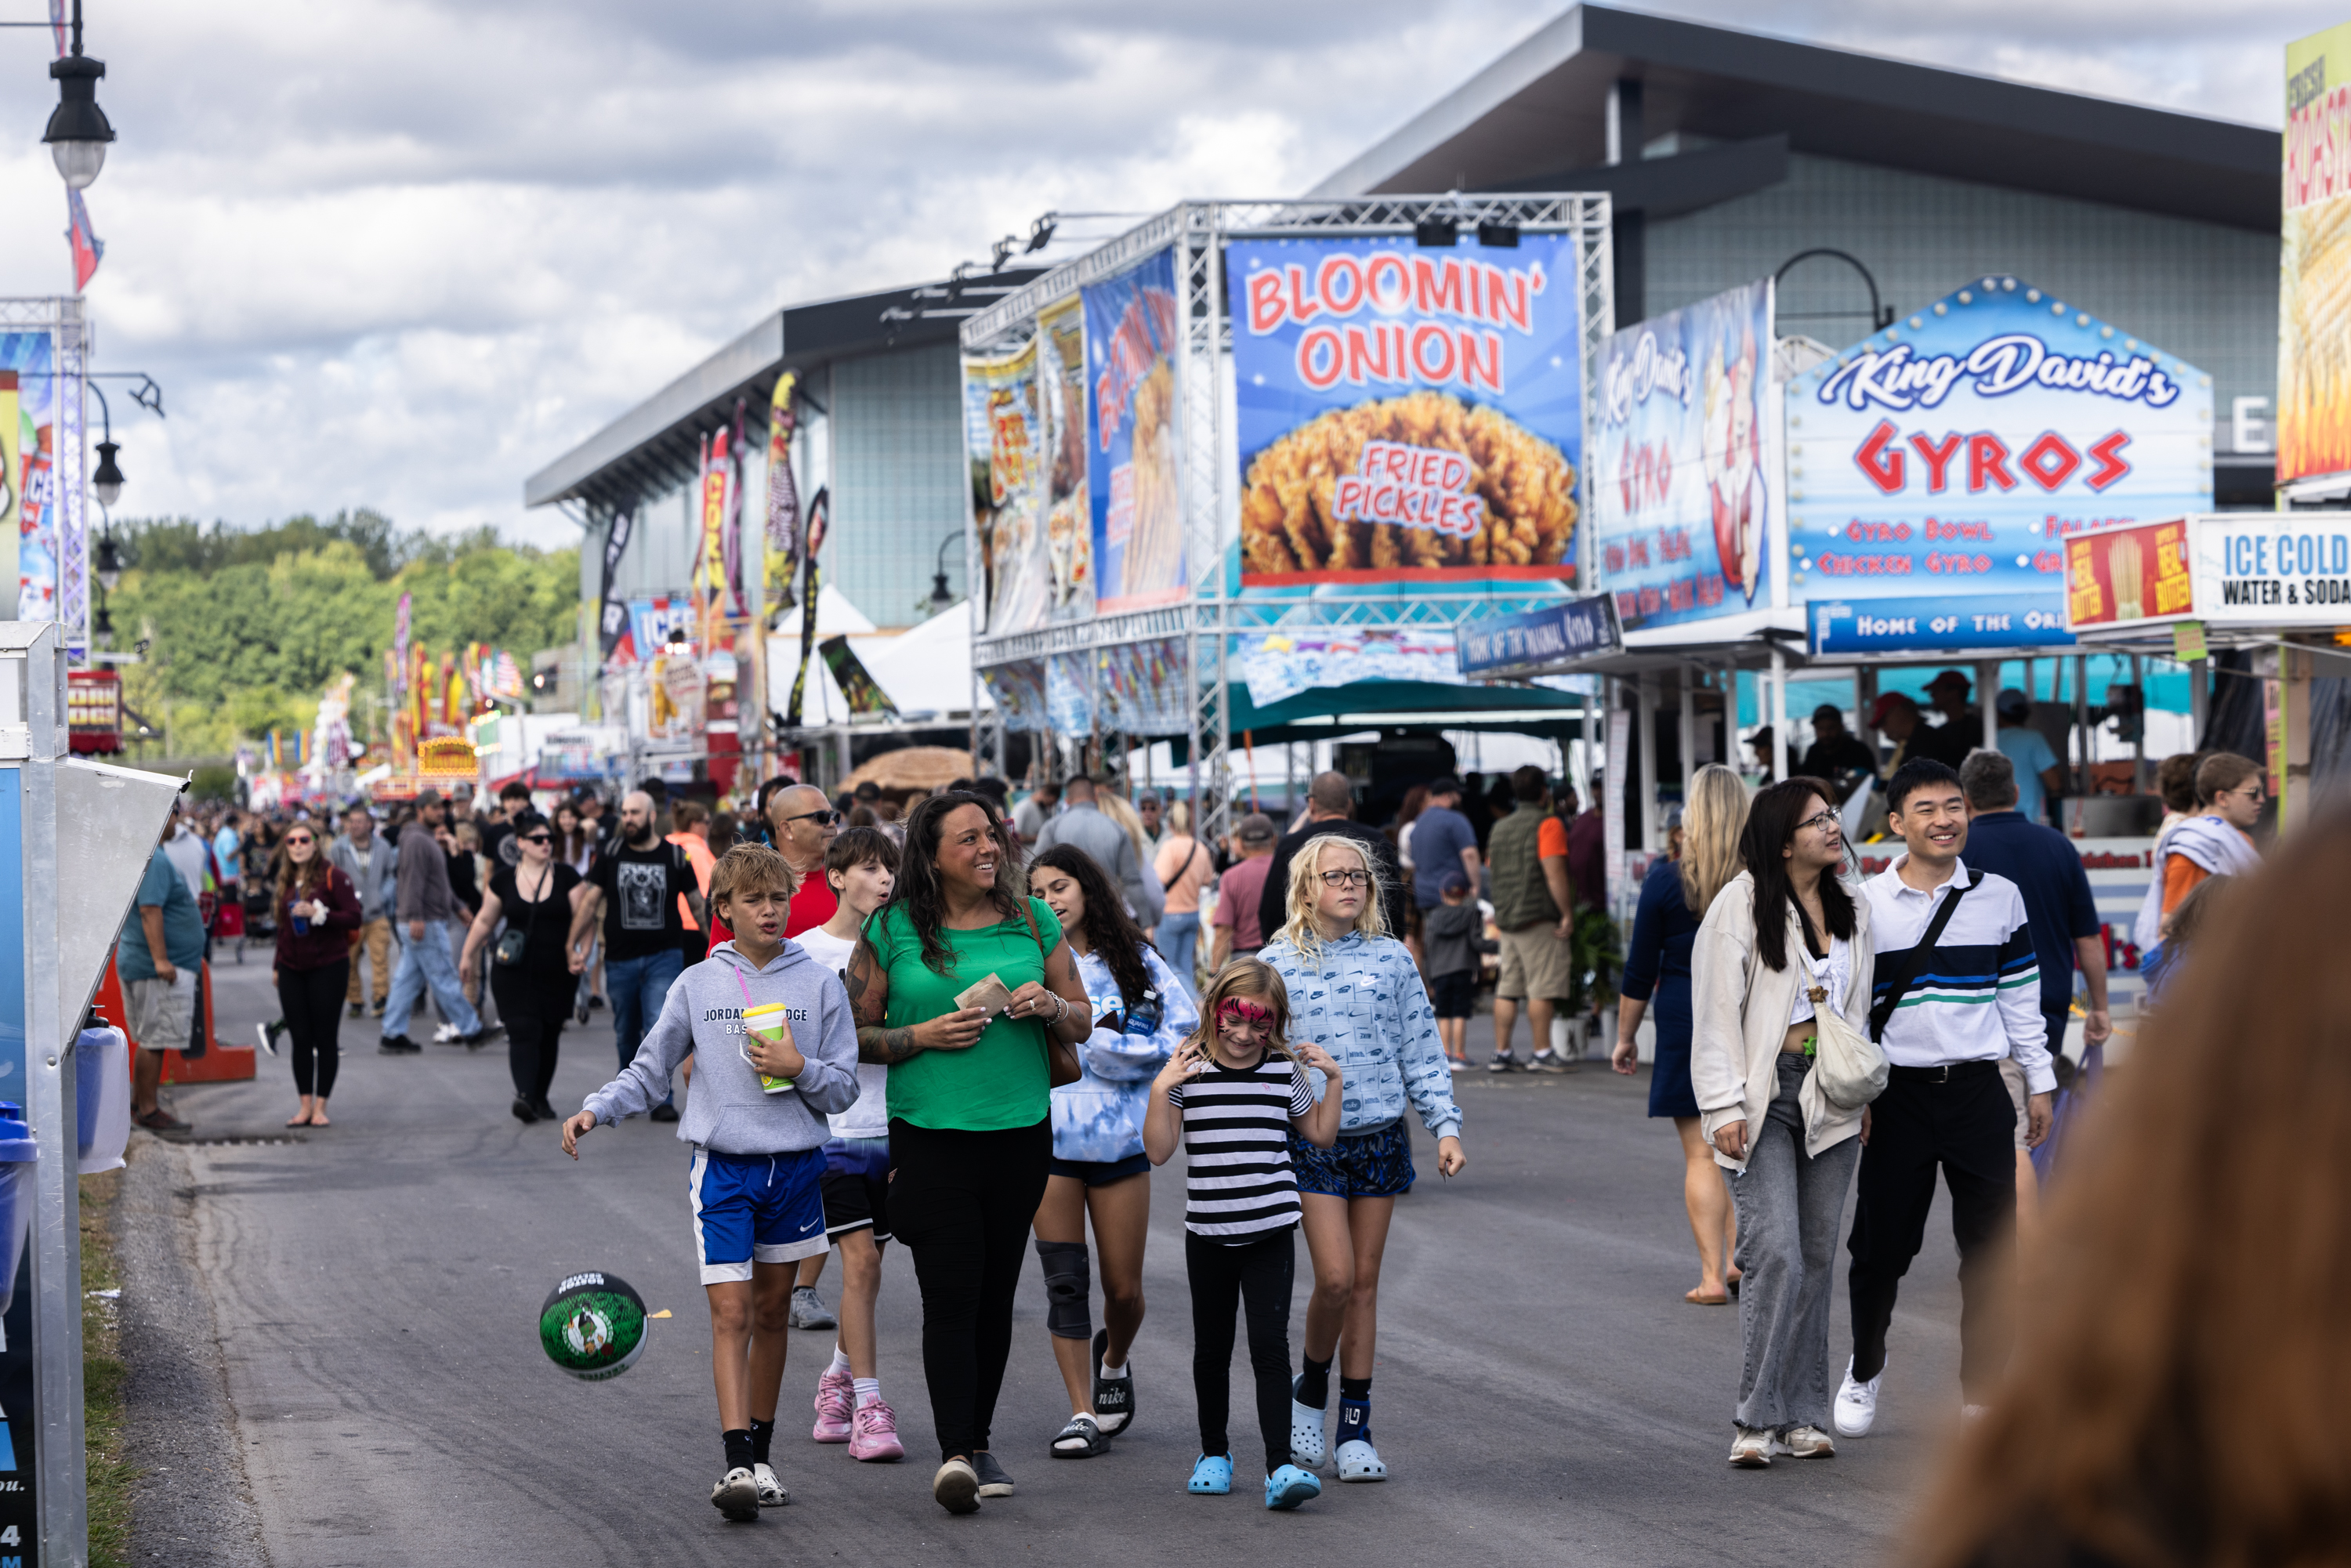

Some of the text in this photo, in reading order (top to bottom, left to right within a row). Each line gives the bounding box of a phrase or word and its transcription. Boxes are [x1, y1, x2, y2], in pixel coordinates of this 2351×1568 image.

[2286, 81, 2351, 209] ROAST
[1245, 252, 1546, 335] BLOOMIN'
[1295, 320, 1504, 395] ONION
[1819, 334, 2179, 410] King David's
[1364, 442, 1467, 491] FRIED
[1854, 418, 2131, 494] GYROS
[1335, 477, 1480, 537] PICKLES
[1846, 517, 1993, 542] GYRO BOWL
[1817, 551, 1992, 575] CHICKEN GYRO
[2033, 551, 2063, 573] GR
[2224, 535, 2267, 576] ICE
[2277, 534, 2349, 576] COLD
[2223, 580, 2281, 605] WATER
[2288, 583, 2299, 605] &
[1857, 609, 2064, 636] HOME OF THE ORI
[786, 1009, 808, 1021] DGE
[1127, 1019, 1149, 1030] AQUAFINA
[726, 1024, 748, 1034] BAS
[1099, 1387, 1126, 1405] nike
